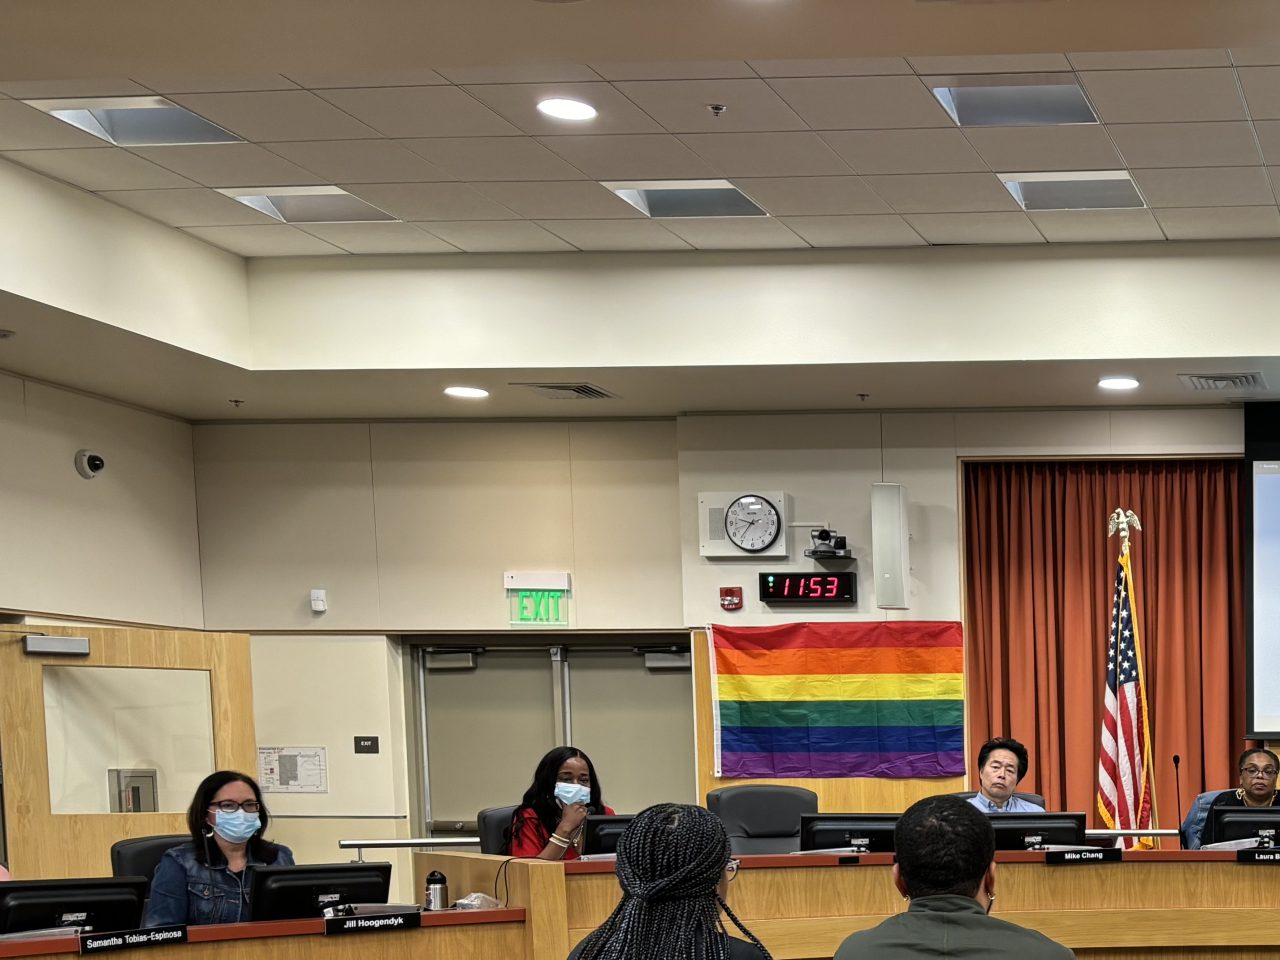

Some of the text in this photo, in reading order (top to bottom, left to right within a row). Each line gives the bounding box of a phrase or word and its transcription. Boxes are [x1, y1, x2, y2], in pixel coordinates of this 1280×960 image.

[518, 590, 562, 620] EXIT
[1064, 851, 1103, 860] Mike Chang
[1255, 852, 1274, 860] Laura
[343, 916, 404, 929] Jill Hoogendyk
[86, 930, 182, 949] Samantha Tobias-Espinosa
